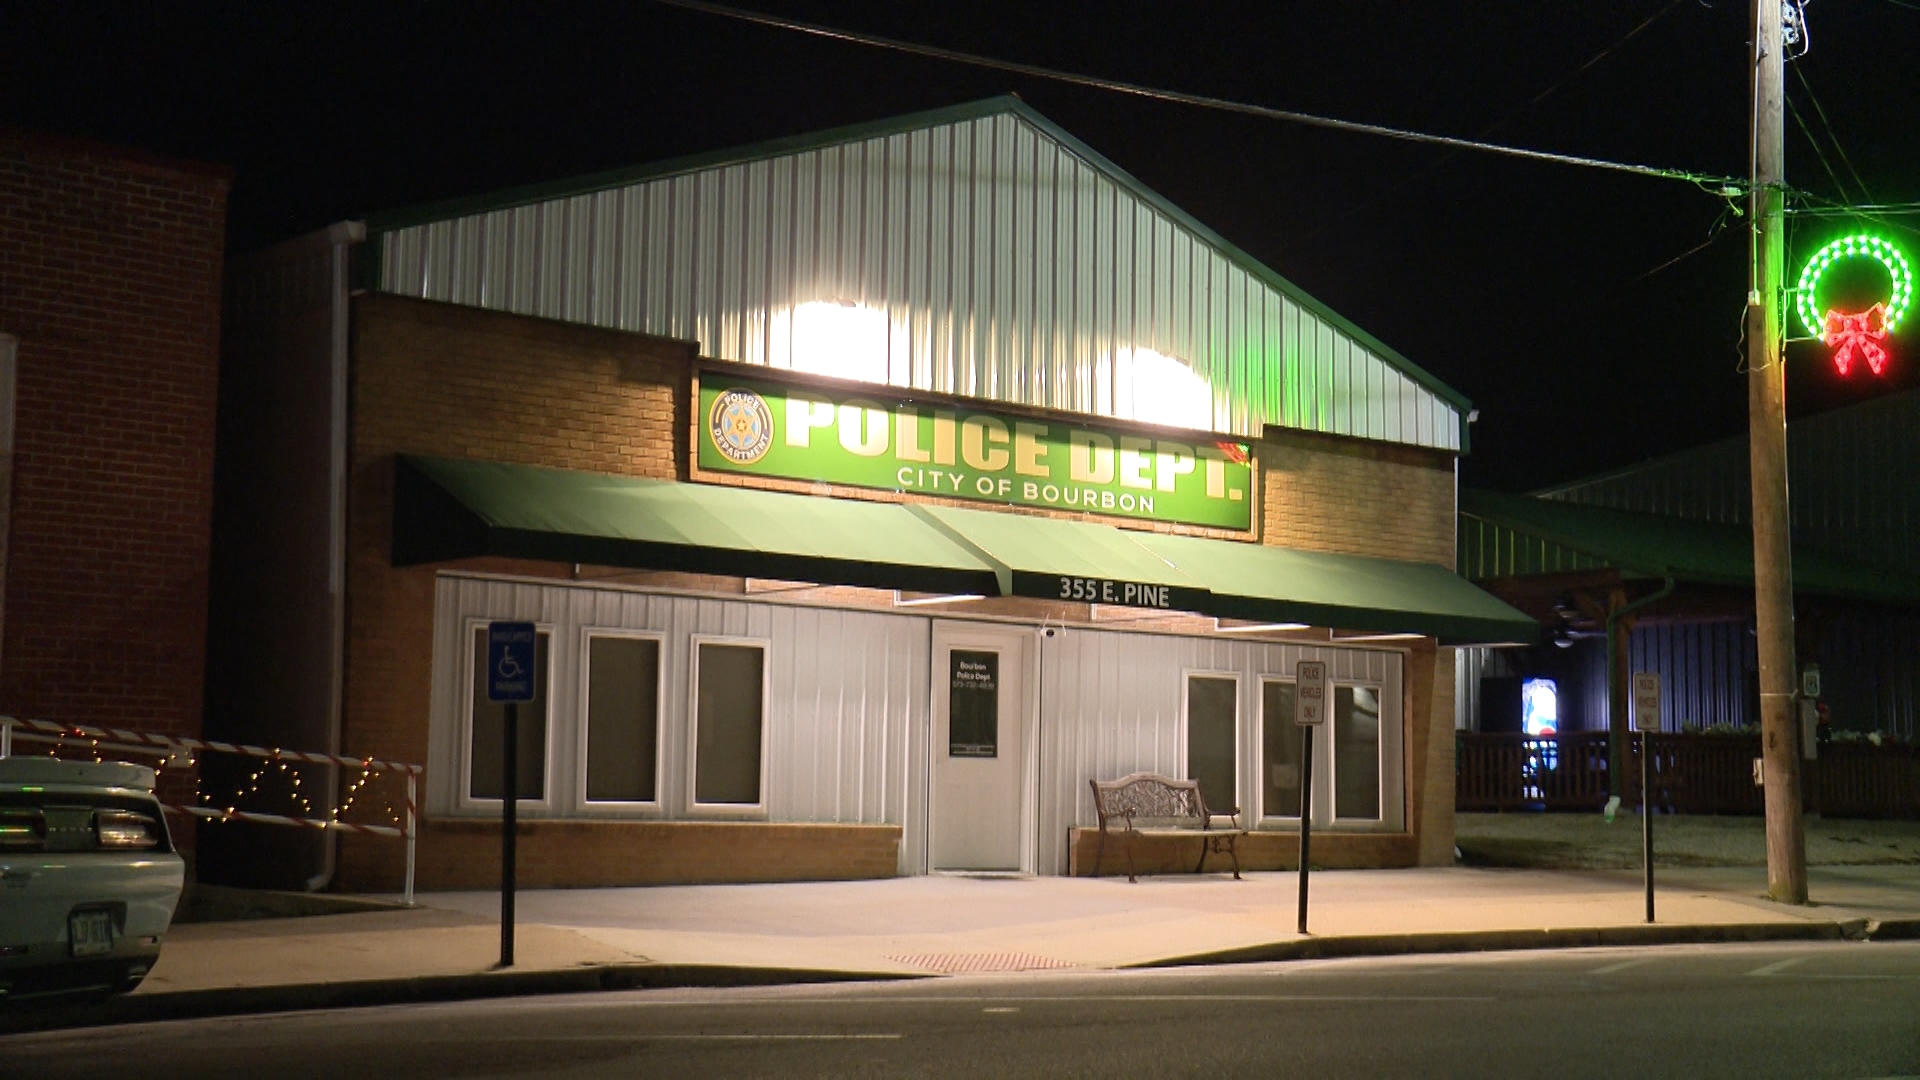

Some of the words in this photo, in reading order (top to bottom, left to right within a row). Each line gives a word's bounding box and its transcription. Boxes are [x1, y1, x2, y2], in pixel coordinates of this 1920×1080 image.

[724, 392, 760, 410] POLICE
[714, 428, 769, 460] DEPARTMENT
[785, 389, 1050, 478] POLICE
[1069, 429, 1243, 501] DEPT.
[897, 467, 965, 492] CITY
[976, 477, 1012, 497] OF
[1023, 481, 1155, 514] BOURBON
[1060, 577, 1097, 600] 355
[1102, 581, 1120, 602] E.
[1124, 583, 1170, 608] PINE
